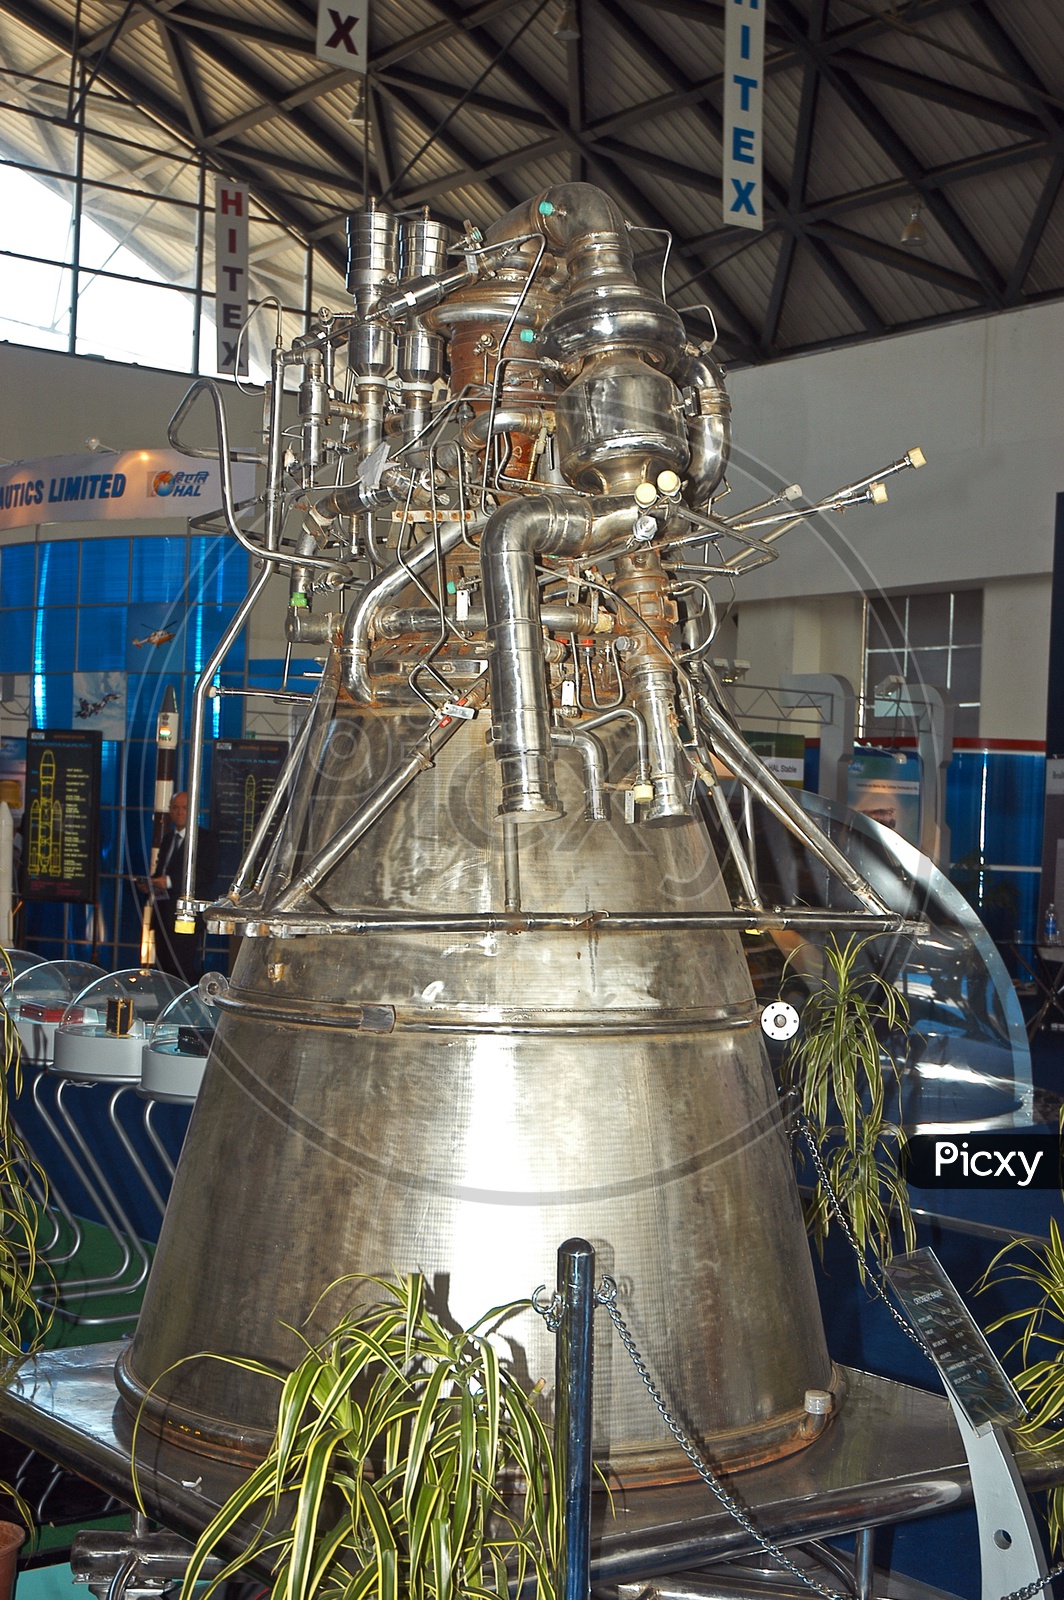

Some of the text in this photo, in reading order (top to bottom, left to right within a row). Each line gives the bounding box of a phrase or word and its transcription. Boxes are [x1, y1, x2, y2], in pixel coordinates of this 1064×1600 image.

[730, 0, 758, 216] ITEX
[220, 189, 244, 368] HITEX
[48, 473, 127, 503] LIMITED
[172, 485, 201, 497] HAL
